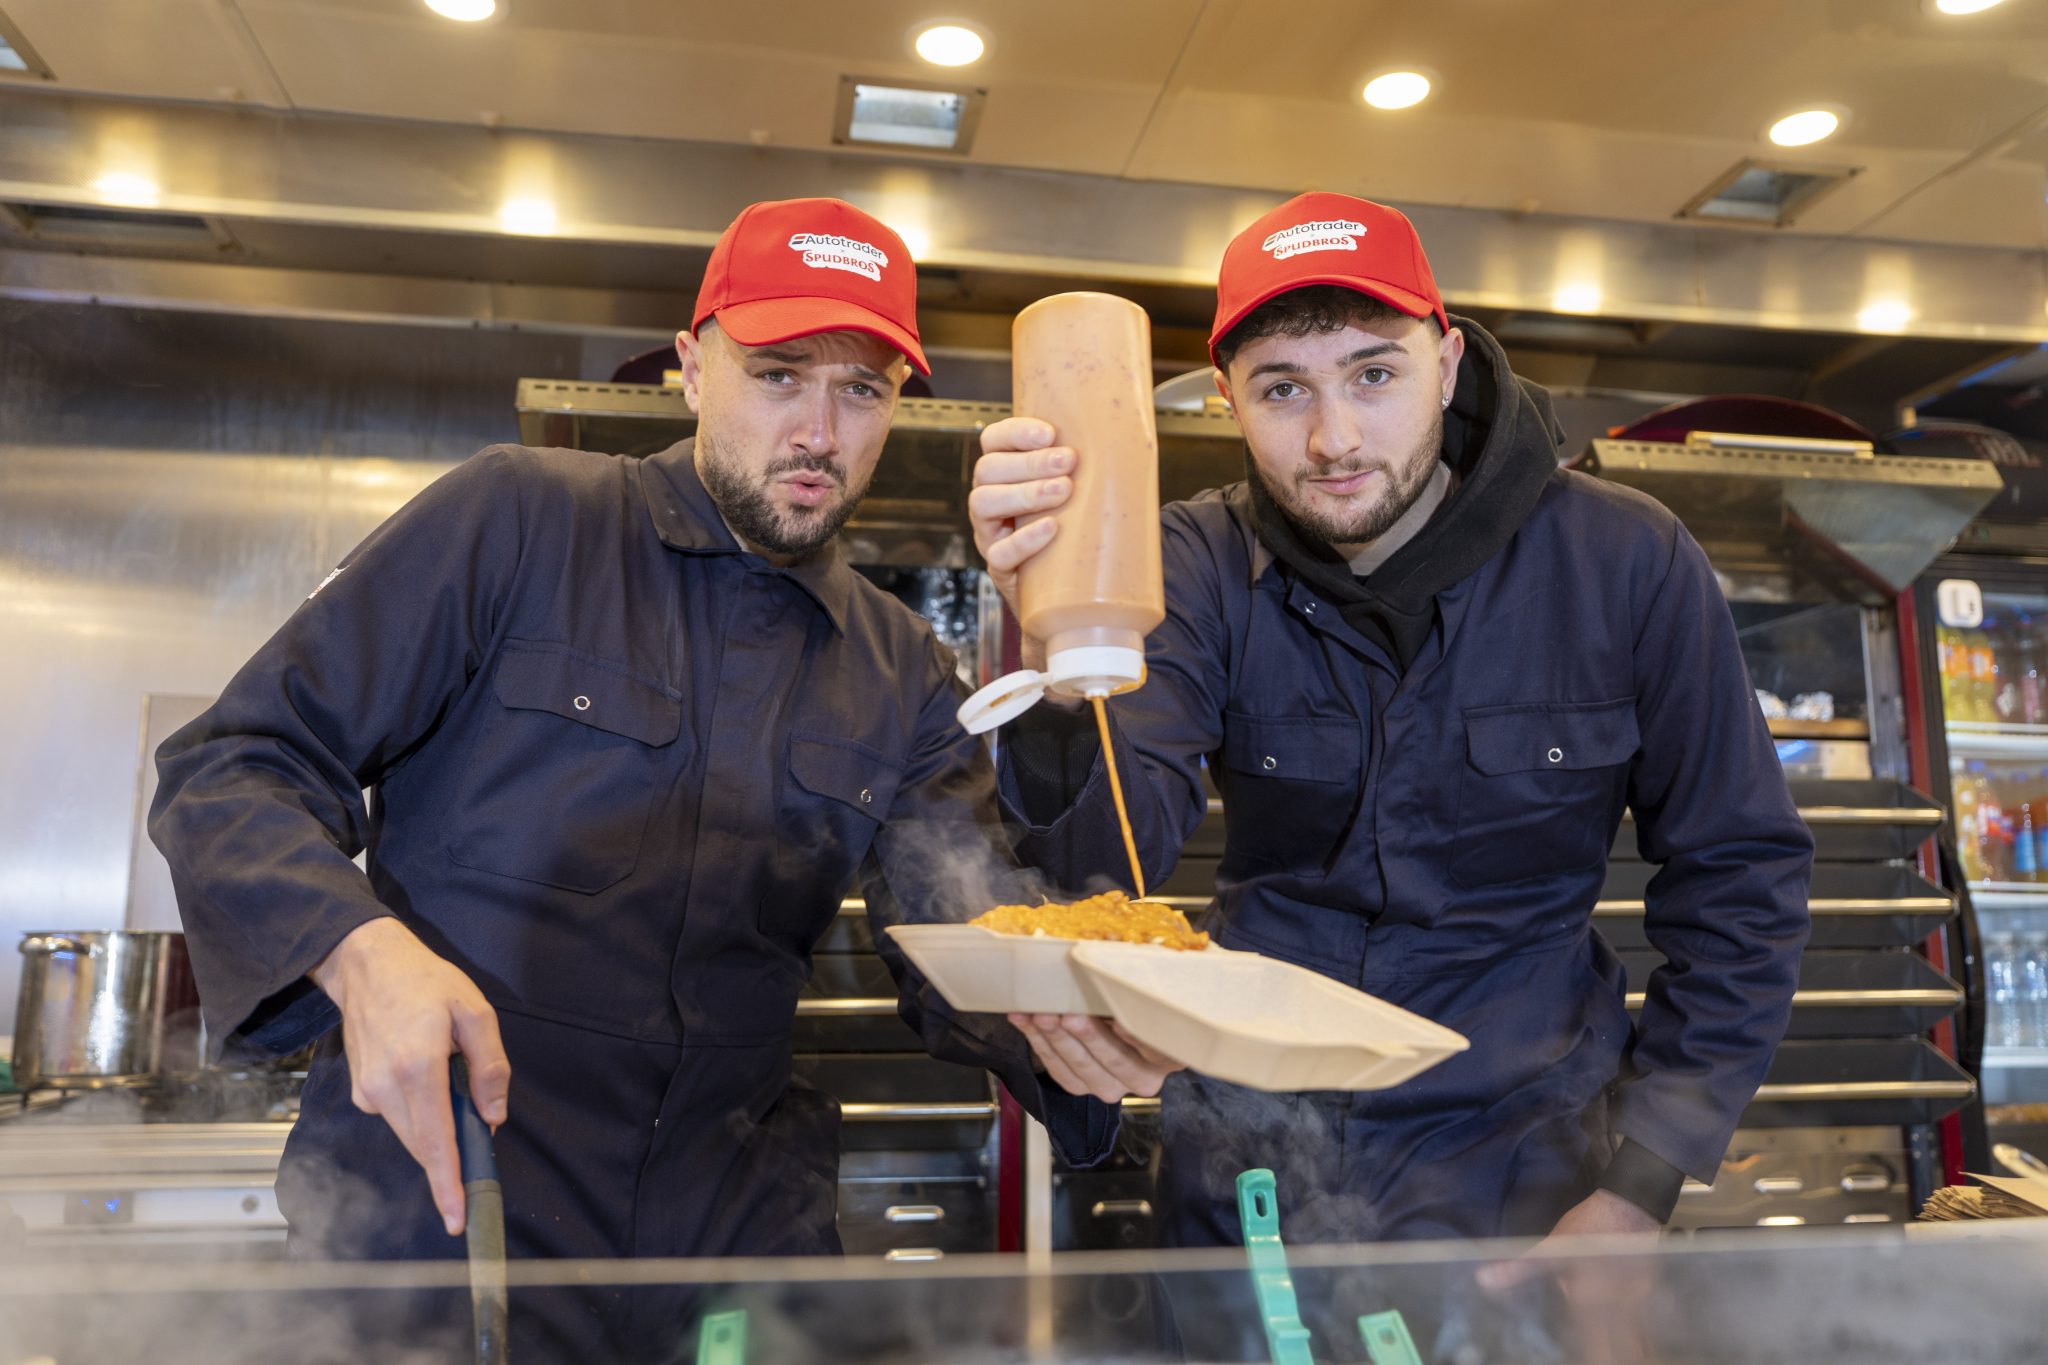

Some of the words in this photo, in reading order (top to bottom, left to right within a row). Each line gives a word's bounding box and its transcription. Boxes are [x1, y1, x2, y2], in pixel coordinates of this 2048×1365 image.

[1276, 220, 1359, 242] Autotrader
[805, 235, 883, 259] Autotrader
[1275, 236, 1350, 257] SPUDBROS
[805, 252, 875, 273] SPUDBROS
